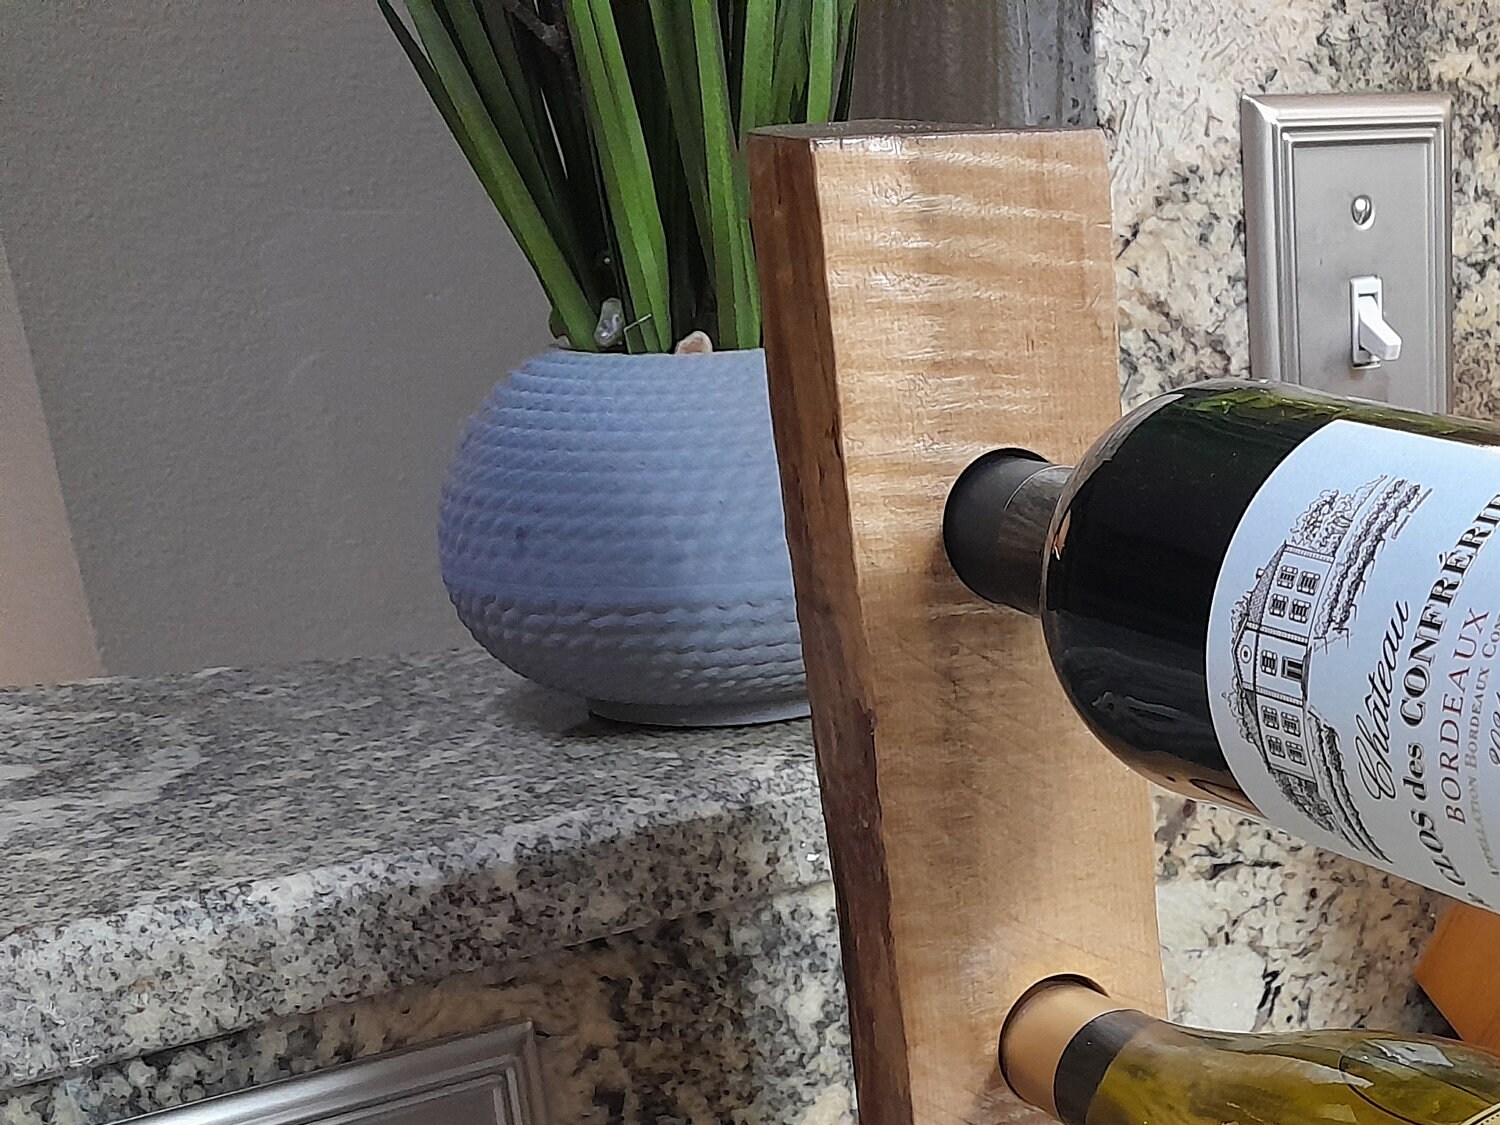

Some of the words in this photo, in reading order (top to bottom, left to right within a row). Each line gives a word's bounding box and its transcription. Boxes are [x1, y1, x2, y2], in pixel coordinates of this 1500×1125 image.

[1355, 600, 1409, 800] Château
[1402, 743, 1428, 801] des
[1439, 608, 1490, 825] BORDEAUX
[1465, 667, 1490, 769] BORDEAUX
